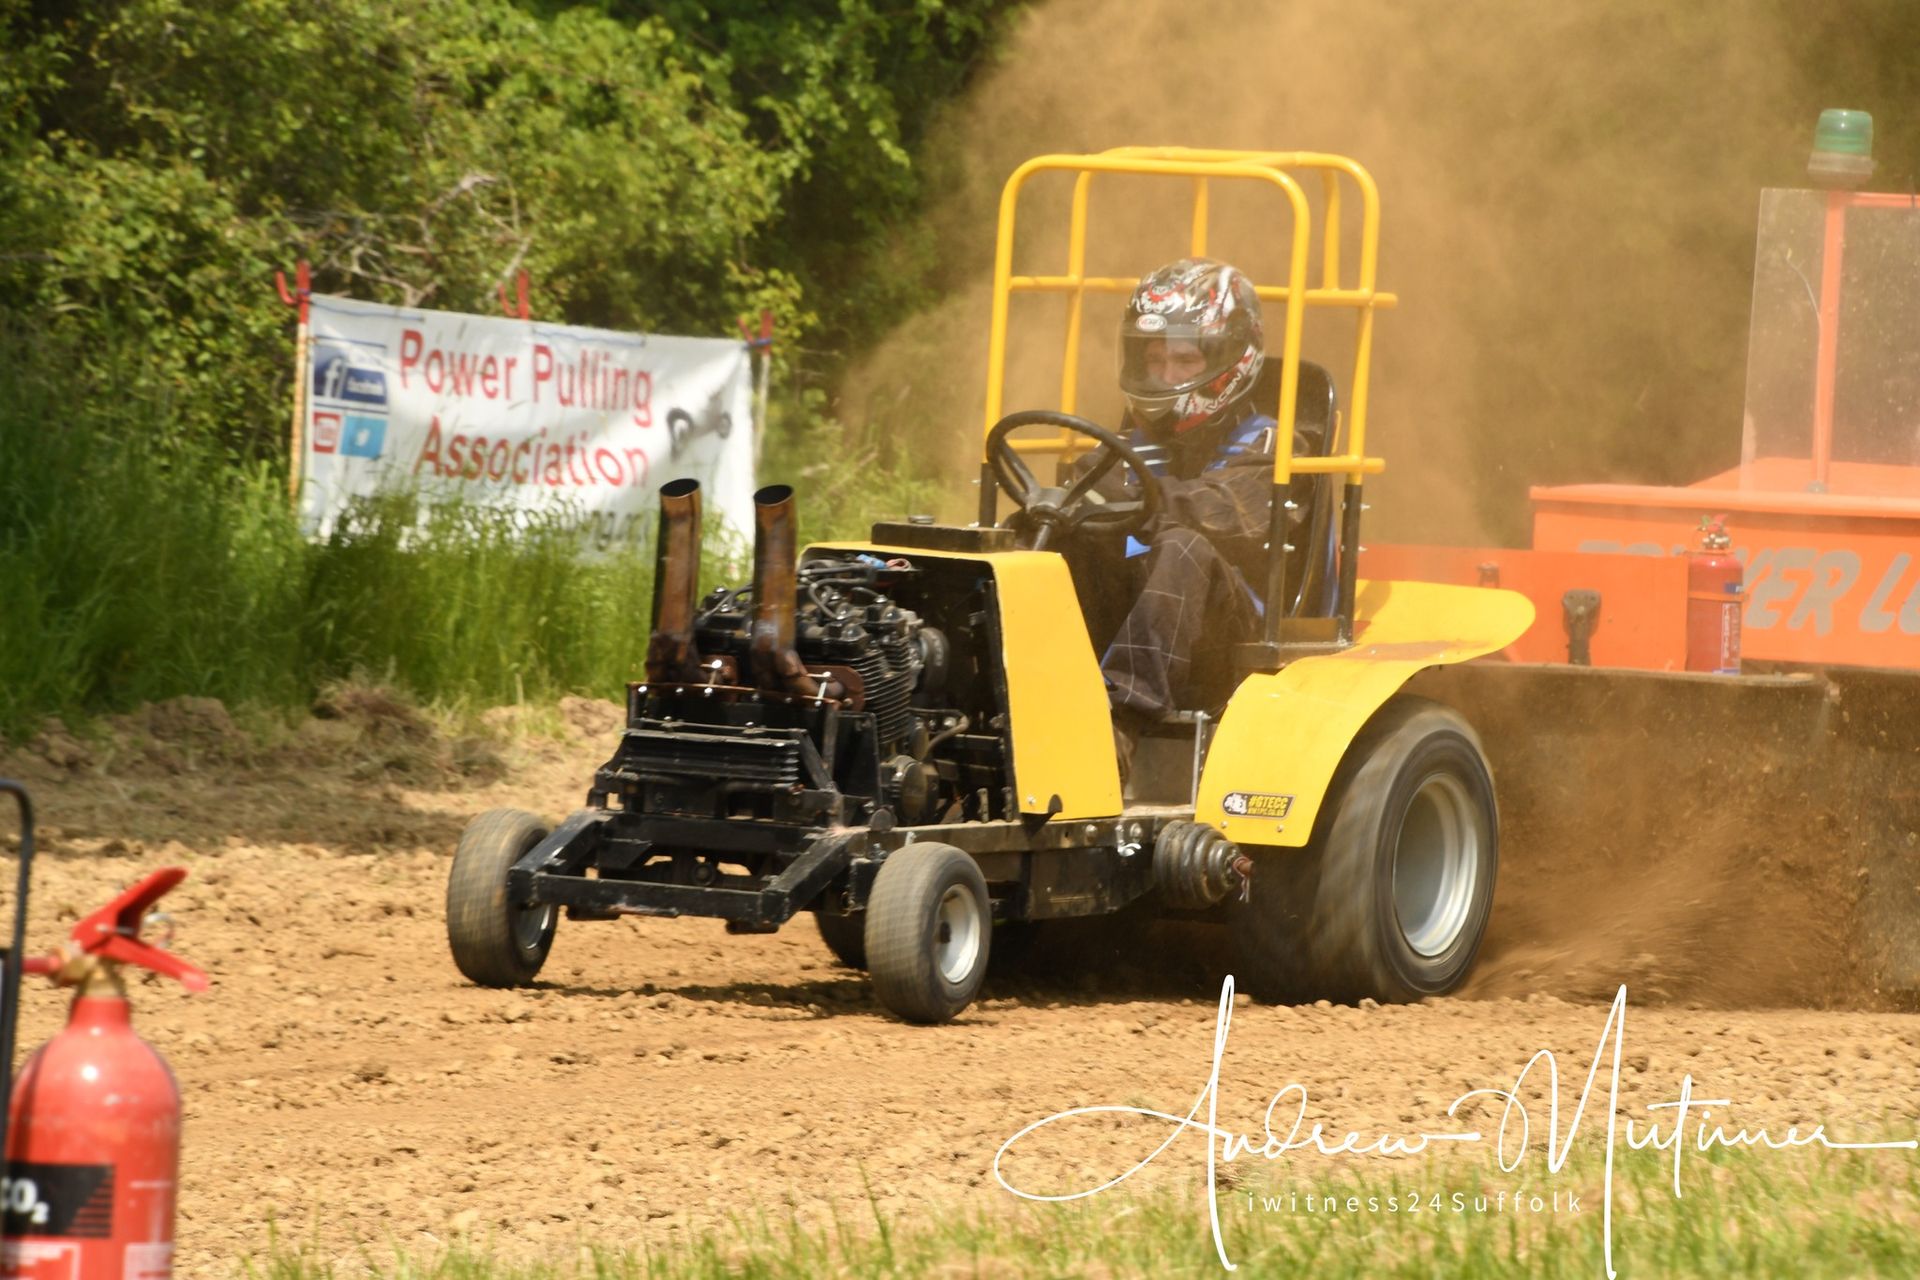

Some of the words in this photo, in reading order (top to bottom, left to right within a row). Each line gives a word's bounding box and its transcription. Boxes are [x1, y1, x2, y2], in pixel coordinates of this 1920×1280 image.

[400, 329, 517, 400] Power
[533, 344, 652, 428] Pulling
[413, 415, 649, 487] Association
